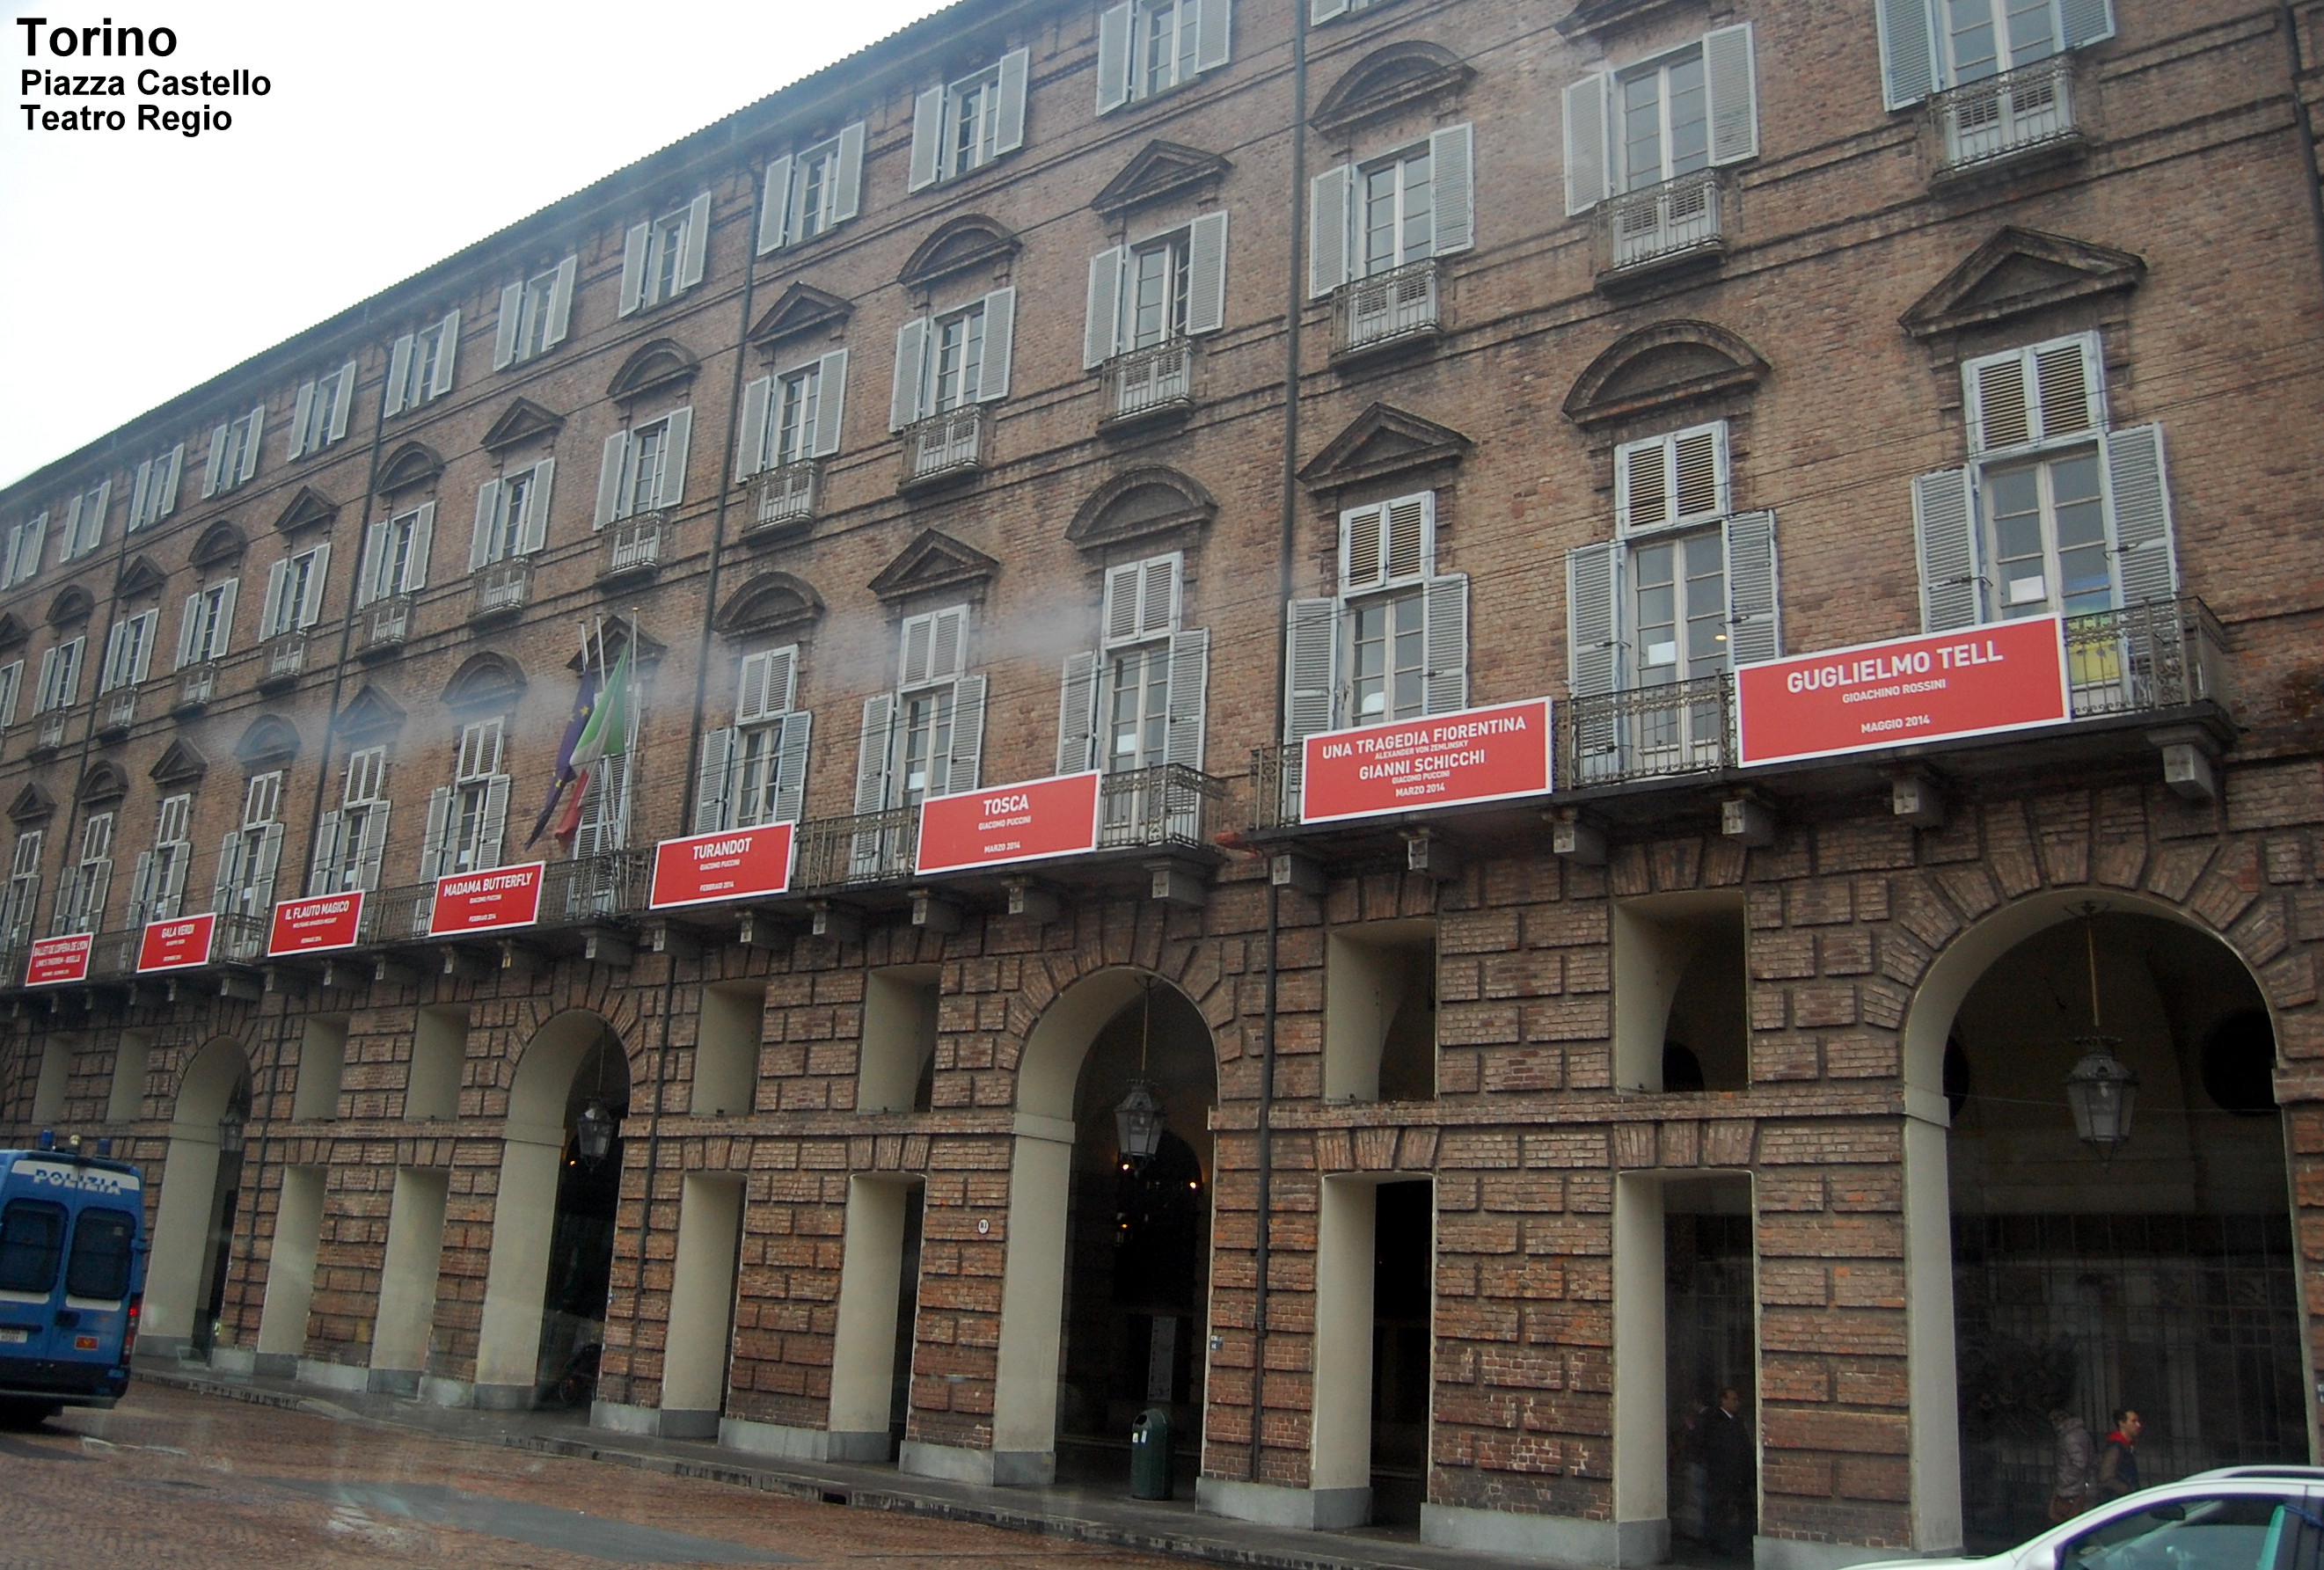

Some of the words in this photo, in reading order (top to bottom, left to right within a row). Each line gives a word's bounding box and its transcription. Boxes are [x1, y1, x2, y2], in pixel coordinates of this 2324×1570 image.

[1787, 651, 1931, 693] GUGLIELMO
[1936, 639, 2004, 669] TELL
[1842, 684, 1900, 705] GIOACHINO
[1902, 678, 1947, 695] ROSSINI
[1860, 718, 1904, 734] MAGGIO
[1904, 714, 1931, 728] 2014
[1322, 742, 1353, 759] UNA
[1356, 730, 1429, 754] TRAGEDIA
[1433, 715, 1526, 745] FIORENTINA
[1375, 747, 1414, 760] ALEXANDER
[1415, 745, 1429, 754] VON
[1359, 759, 1410, 781] GIANNI
[1414, 749, 1485, 772] SCHICCHI
[1392, 773, 1421, 785] GIACOMO
[1422, 769, 1451, 780] PUCCINI
[1395, 785, 1425, 798] MARZO
[1426, 782, 1445, 793] 2014
[983, 793, 1029, 816] TOSCA
[1006, 815, 1031, 827] PUCCINI
[692, 836, 752, 860] TURANDOT
[984, 843, 1005, 853] MARZO
[1006, 841, 1020, 851] 2014
[443, 880, 481, 897] MADAMA
[482, 872, 533, 892] BUTTERFLY
[285, 909, 293, 920] IL
[293, 903, 321, 920] FLAUTO
[321, 900, 350, 915] MAGICO
[33, 1168, 121, 1195] POLIZIA
